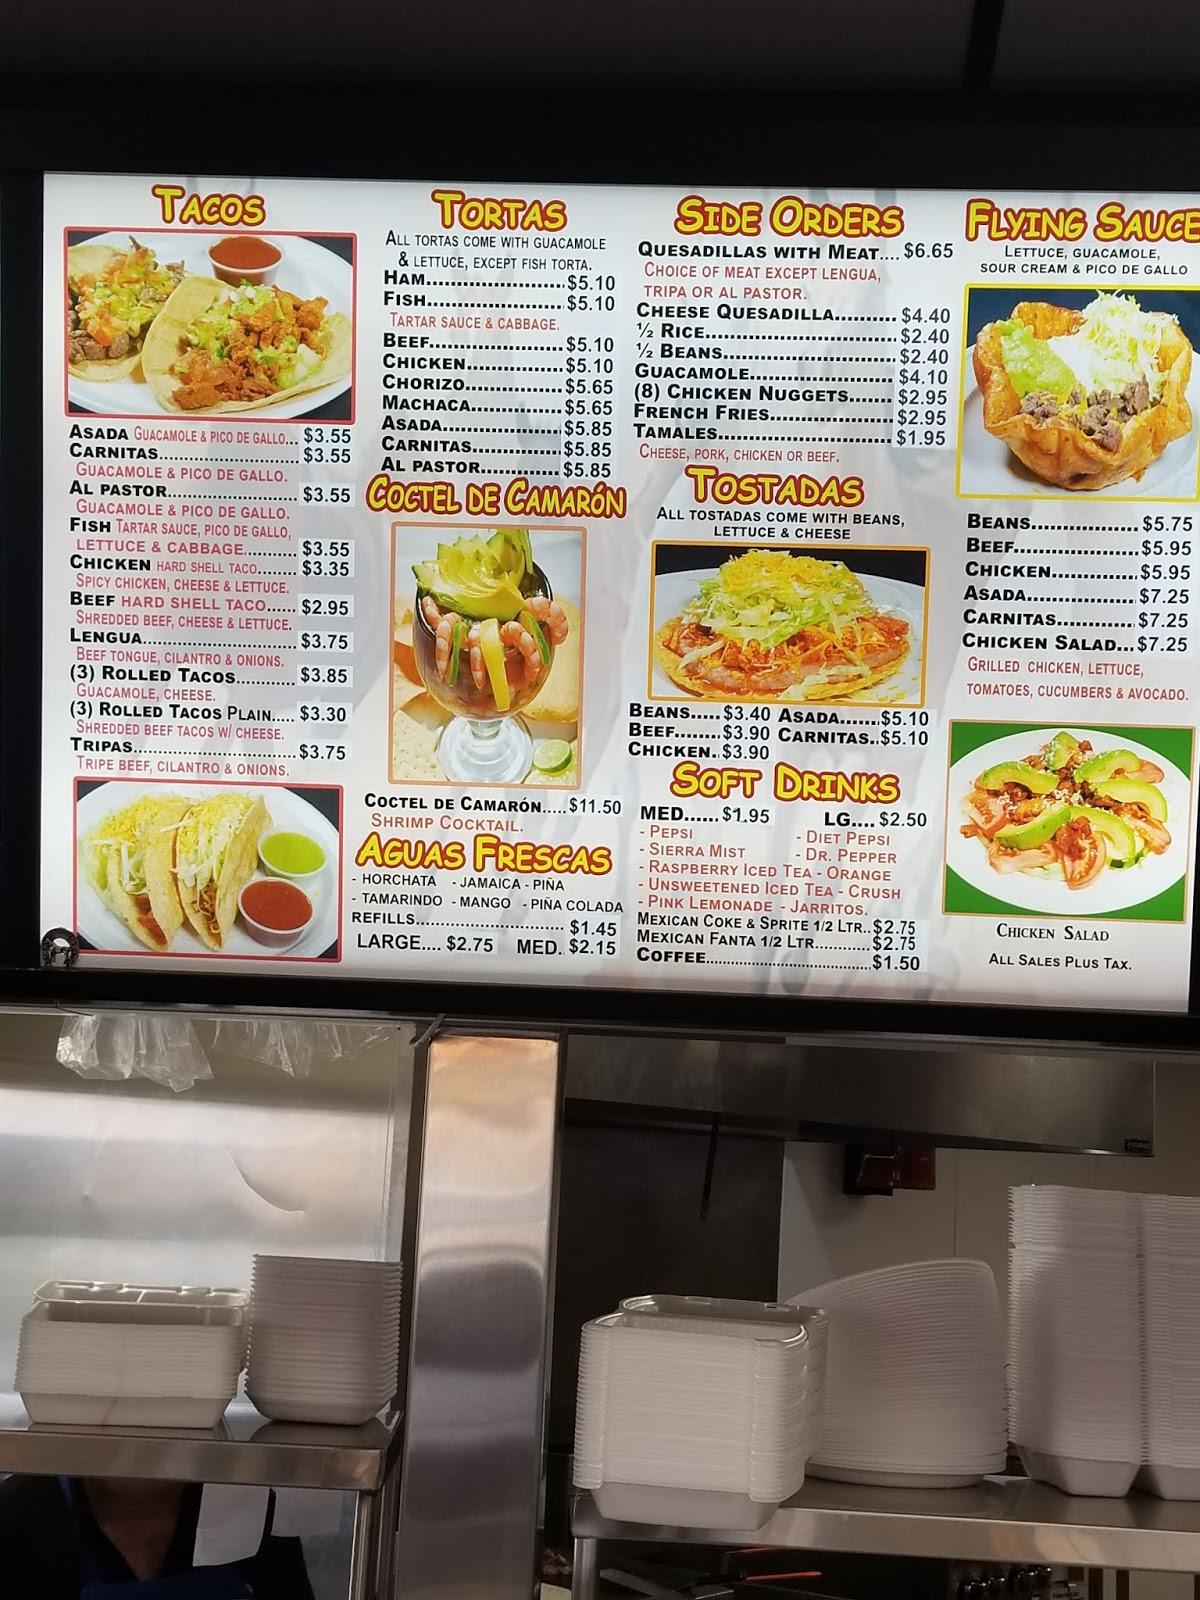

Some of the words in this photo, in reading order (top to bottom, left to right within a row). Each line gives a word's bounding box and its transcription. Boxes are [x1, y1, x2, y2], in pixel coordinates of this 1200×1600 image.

[416, 235, 458, 247] TORTAS
[463, 236, 496, 247] COME
[501, 236, 528, 248] WITH
[774, 247, 820, 259] WITH
[904, 242, 953, 259] $6.65
[474, 258, 517, 270] EXCEPT
[522, 259, 546, 269] FISH
[980, 264, 1016, 273] SOUR
[1021, 264, 1067, 274] CREAM
[1144, 266, 1188, 275] GALLO
[725, 267, 760, 279] MEAT
[568, 275, 615, 291] $5.10
[644, 285, 686, 298] TRIPA
[567, 296, 615, 312] $5.10
[902, 307, 950, 324] $4.40
[901, 328, 949, 345] $2.40
[899, 369, 947, 386] $4.10
[565, 379, 613, 395] $5.65
[634, 383, 660, 401] (8)
[898, 389, 946, 406] $2.95
[211, 430, 233, 443] PICO
[304, 427, 351, 444] $3.55
[564, 421, 612, 436] $5.85
[896, 429, 945, 447] $1.95
[734, 450, 782, 461] CHICKEN
[180, 468, 211, 480] PICO
[466, 483, 500, 514] DE
[689, 510, 761, 523] TOSTADAS
[1143, 516, 1193, 532] $5.75
[204, 524, 230, 536] PICO
[714, 526, 776, 538] LETTUCE
[77, 539, 145, 552] LETTUCE
[1142, 540, 1191, 556] $5.95
[157, 561, 186, 572] HARD
[191, 561, 224, 573] SHELL
[302, 560, 349, 576] $3.35
[174, 579, 220, 591] CHEESE
[1139, 588, 1189, 604] $7.25
[302, 600, 348, 616] $2.95
[178, 616, 223, 629] CHEESE
[1138, 612, 1188, 628] $7.25
[301, 633, 348, 650] $3.75
[165, 652, 221, 665] CILANTRO
[70, 664, 95, 682] (3)
[301, 667, 347, 684] $3.85
[1038, 685, 1112, 698] CUCUMBERS
[300, 705, 346, 722] $3.30
[724, 705, 770, 722] $3.40
[723, 724, 770, 741] $3.90
[569, 798, 621, 814] $11.50
[879, 811, 926, 828] $2.50
[362, 874, 436, 886] HORCHATA
[460, 877, 520, 890] JAMAICA
[533, 877, 564, 891] PIÑA
[362, 893, 442, 907] TAMARINDO
[460, 897, 511, 908] MANGO
[566, 900, 624, 913] COLADA
[570, 920, 617, 936] $1.45
[447, 936, 493, 952] $2.75
[569, 939, 616, 955] $2.15
[872, 954, 920, 971] $1.50
